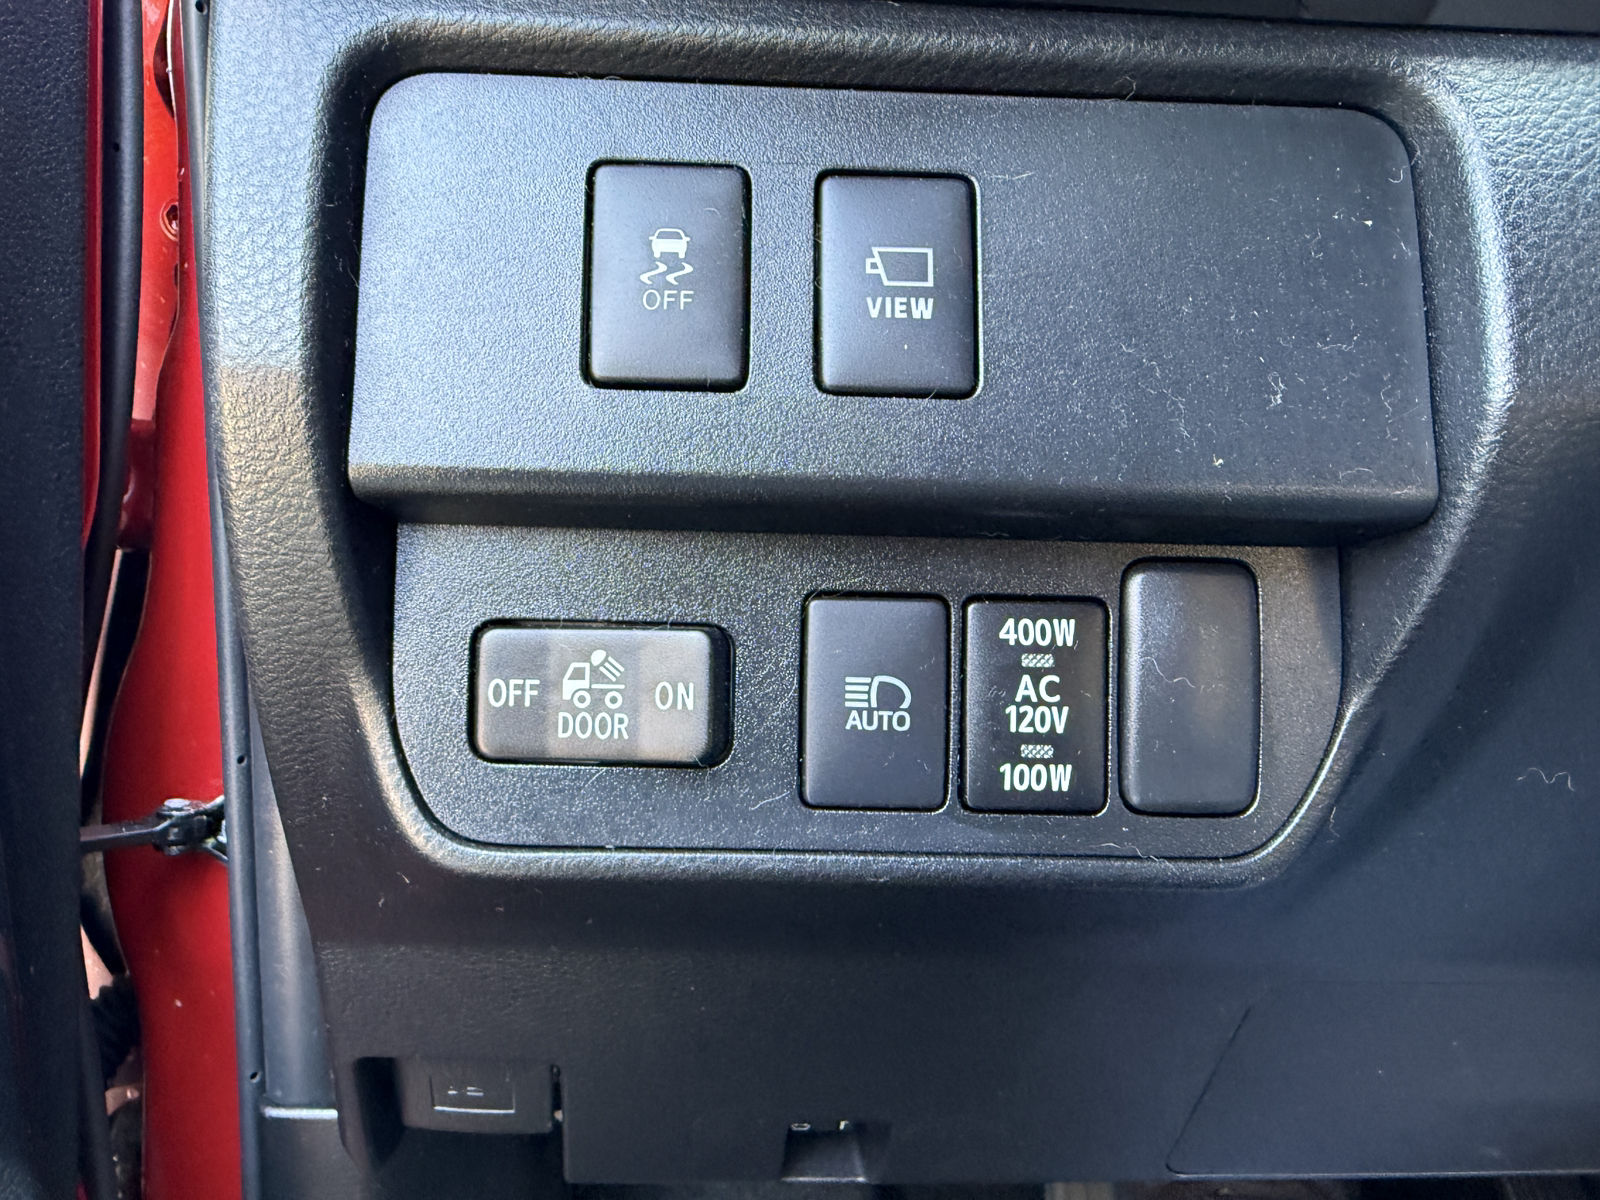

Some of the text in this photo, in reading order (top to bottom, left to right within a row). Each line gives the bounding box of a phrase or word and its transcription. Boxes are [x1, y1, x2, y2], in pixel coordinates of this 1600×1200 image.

[642, 289, 695, 311] OFF
[865, 296, 934, 320] VIEW
[998, 617, 1076, 647] 400W
[487, 677, 541, 708] OFF
[654, 681, 694, 711] ON
[1014, 674, 1061, 703] AC
[557, 711, 629, 740] DOOR
[844, 709, 911, 732] AUTO
[1005, 704, 1070, 734] 120V
[999, 762, 1073, 792] 100W
